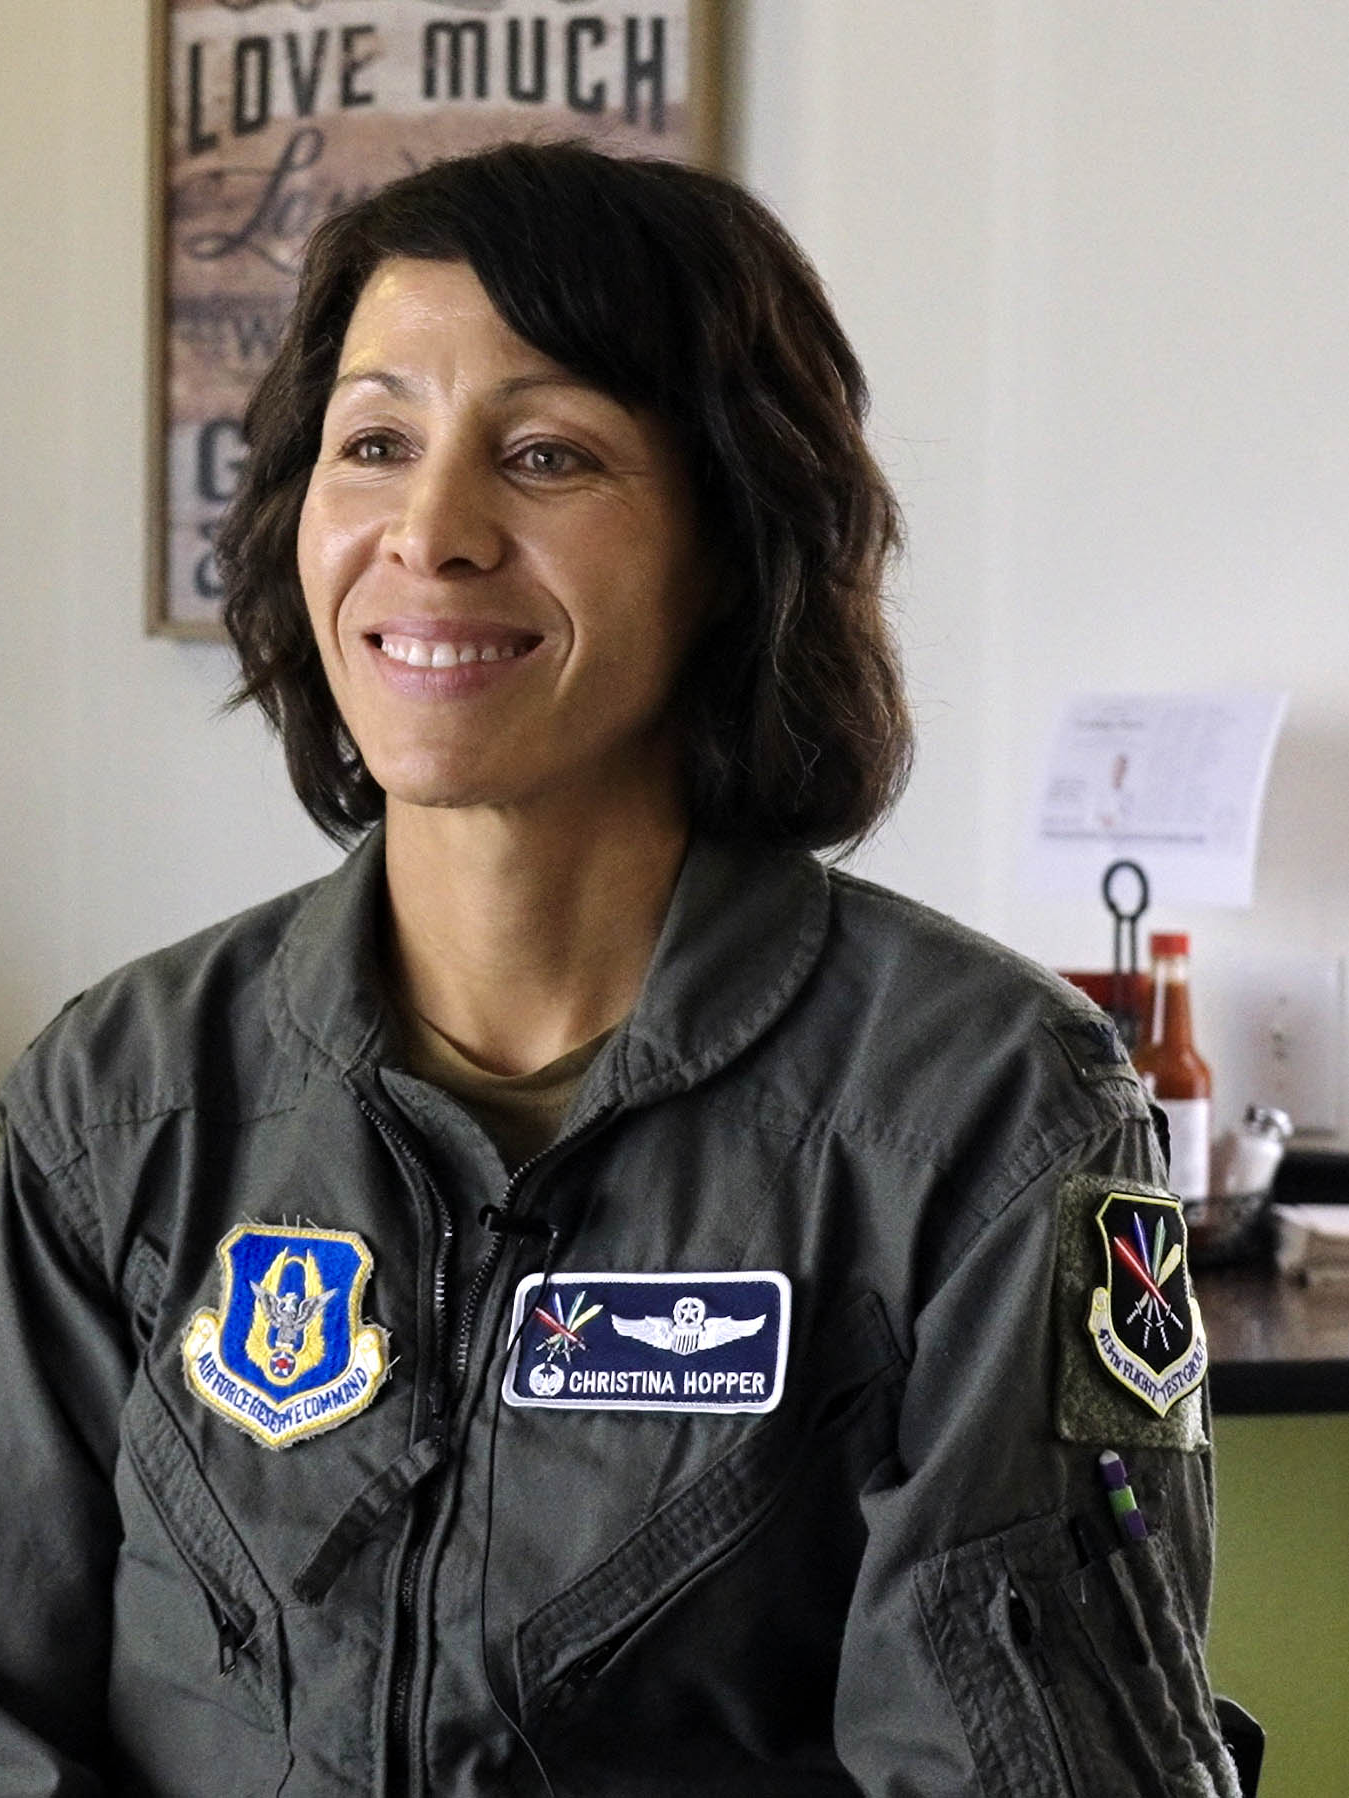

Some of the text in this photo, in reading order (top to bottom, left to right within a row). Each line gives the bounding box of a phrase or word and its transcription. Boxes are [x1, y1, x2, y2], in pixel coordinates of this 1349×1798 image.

[188, 15, 667, 156] LOVE MUCH
[197, 1350, 216, 1385] AIR
[213, 1372, 252, 1415] FORCE
[303, 1366, 369, 1419] COMMAND
[569, 1369, 767, 1396] CHRISTINA HOPPER
[1121, 1358, 1159, 1402] FLIGHT
[1156, 1370, 1186, 1403] TEST
